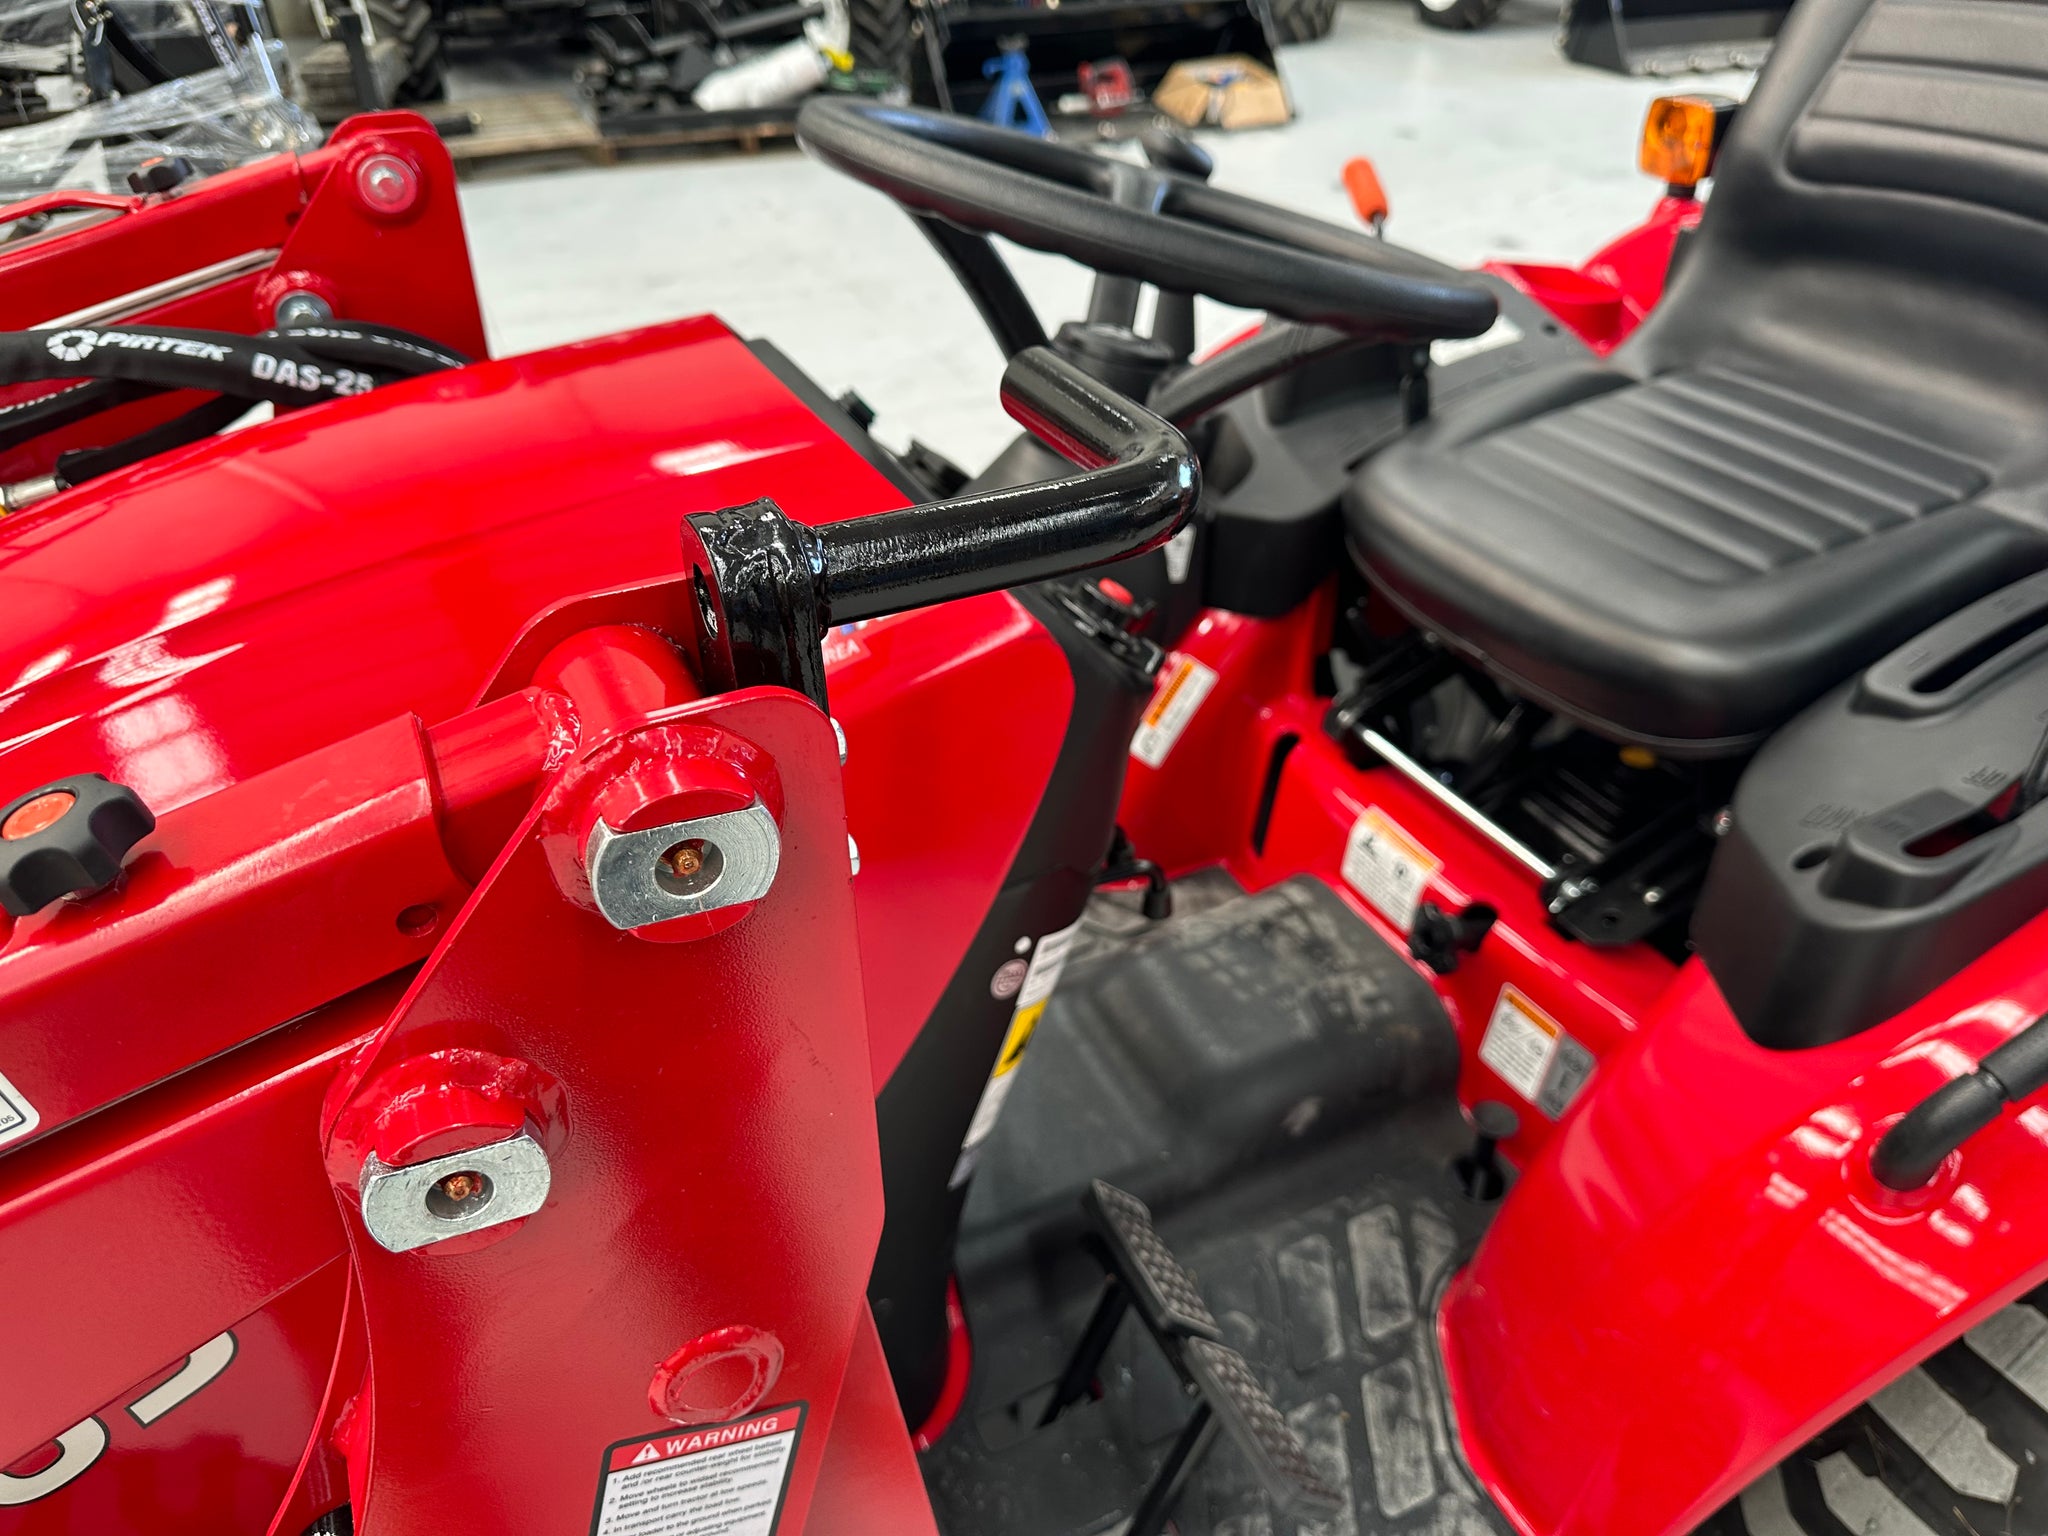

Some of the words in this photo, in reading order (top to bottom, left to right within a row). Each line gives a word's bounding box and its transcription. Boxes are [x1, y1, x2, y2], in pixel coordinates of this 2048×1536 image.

[97, 331, 233, 362] PIRTEK
[823, 638, 861, 666] REA
[666, 1416, 778, 1455] WARNING
[622, 1481, 638, 1489] and
[655, 1473, 672, 1481] rear
[740, 1453, 751, 1461] for
[623, 1472, 641, 1481] Add
[643, 1457, 707, 1476] recommended
[709, 1453, 725, 1461] rear
[728, 1446, 752, 1456] wheel
[620, 1491, 644, 1501] Move
[647, 1483, 676, 1494] wheels
[719, 1457, 779, 1476] recommended
[616, 1510, 640, 1520] Move
[642, 1505, 659, 1514] and
[680, 1494, 708, 1504] tractor
[618, 1497, 648, 1510] setting
[661, 1485, 697, 1498] increase
[624, 1515, 664, 1530] transport
[665, 1510, 686, 1519] carry
[676, 1519, 690, 1527] the
